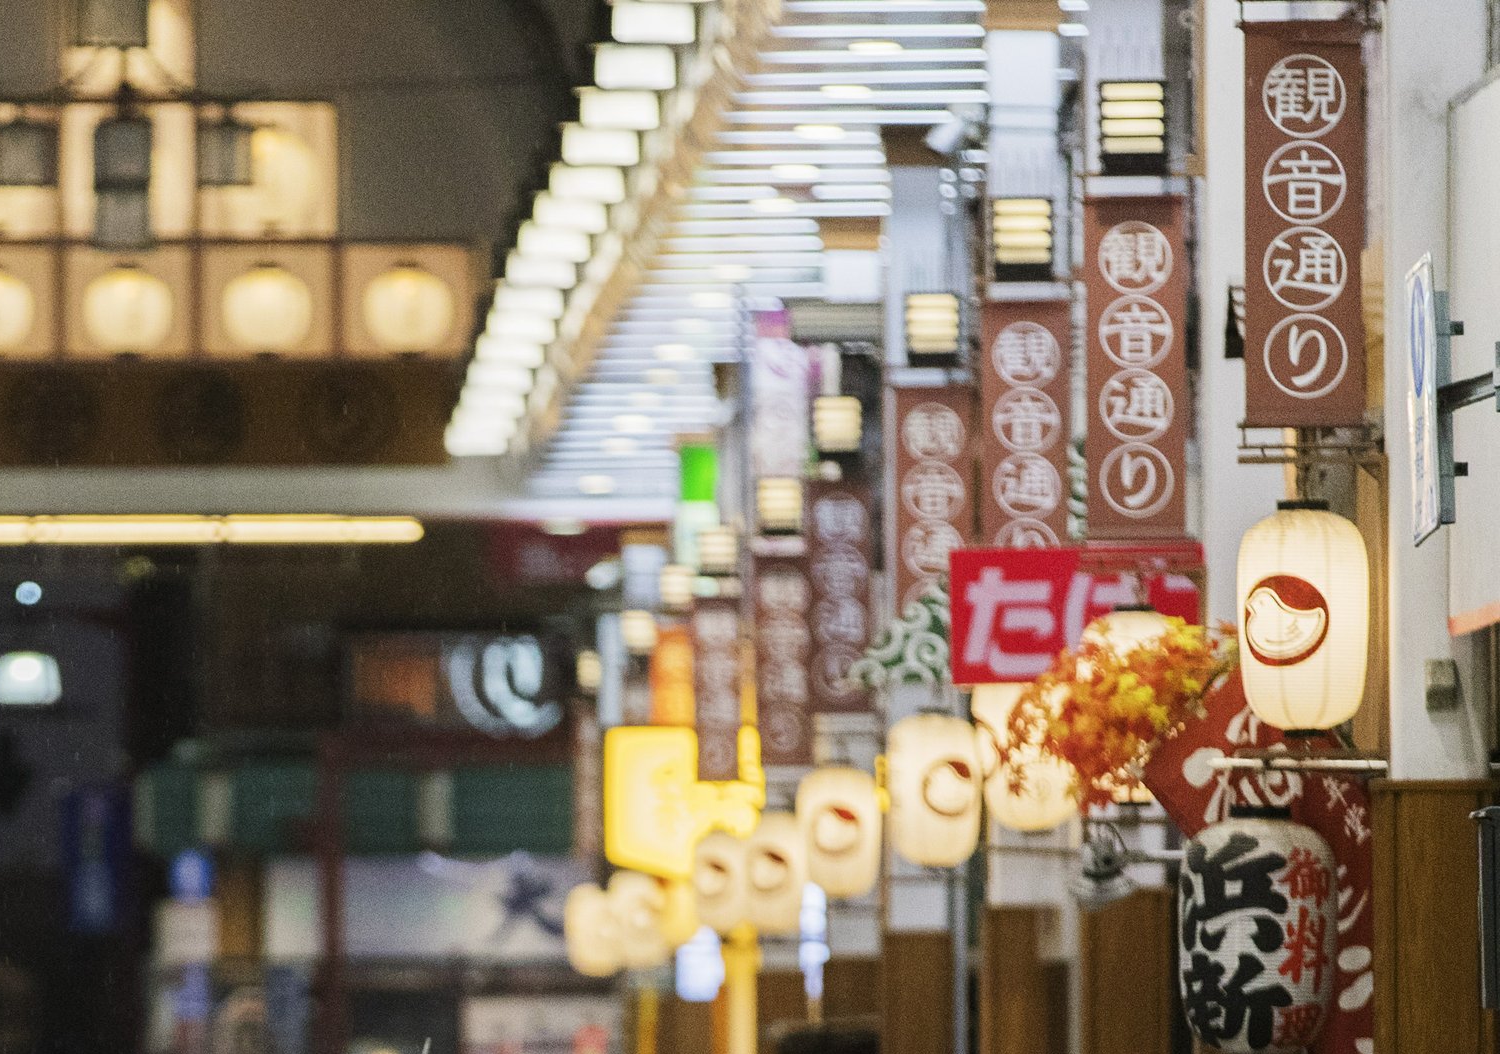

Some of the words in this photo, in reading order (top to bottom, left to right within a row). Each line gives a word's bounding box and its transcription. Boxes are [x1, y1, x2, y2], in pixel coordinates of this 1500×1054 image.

[1100, 222, 1174, 517] 観音通り
[1263, 55, 1347, 397] 観音通り
